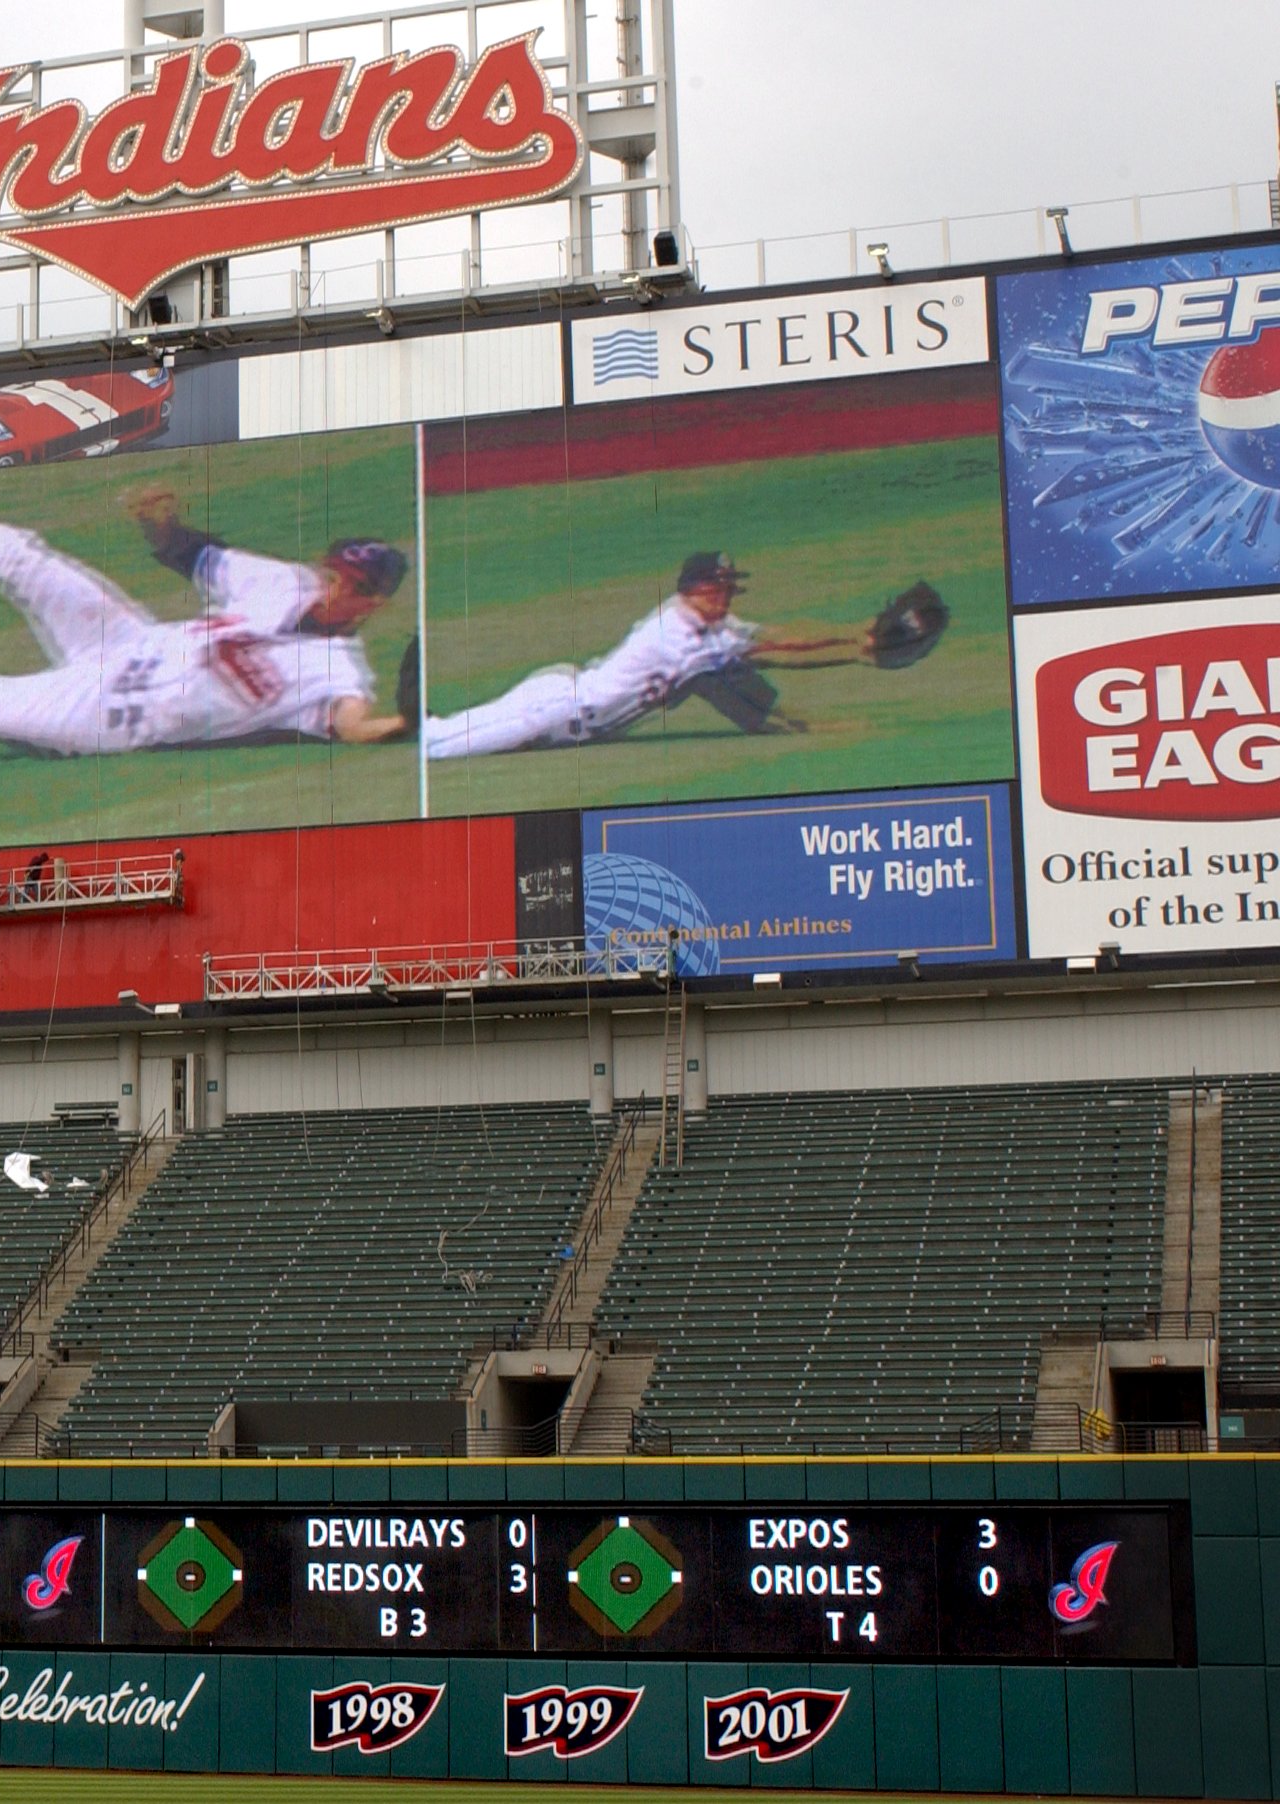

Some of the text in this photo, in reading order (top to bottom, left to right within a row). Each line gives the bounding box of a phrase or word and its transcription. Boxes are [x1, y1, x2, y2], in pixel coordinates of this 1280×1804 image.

[683, 300, 949, 377] STERIS
[1074, 657, 1280, 727] GIA
[1086, 723, 1280, 792] EAG
[801, 816, 973, 856] Work Hard.
[829, 858, 975, 900] Fly Right.
[1041, 846, 1280, 885] Official sup
[757, 916, 853, 938] Airlines
[1108, 892, 1280, 929] of the In
[307, 1518, 527, 1549] DEVILRAYS 0
[749, 1518, 996, 1548] EXPOS 3
[307, 1563, 528, 1593] REDSOX 3
[750, 1565, 999, 1596] ORIOLES 0
[381, 1608, 427, 1637] B 3
[826, 1611, 878, 1641] T 4
[328, 1692, 415, 1738] 1998
[521, 1696, 613, 1743] 1999
[719, 1700, 811, 1745] 2001
